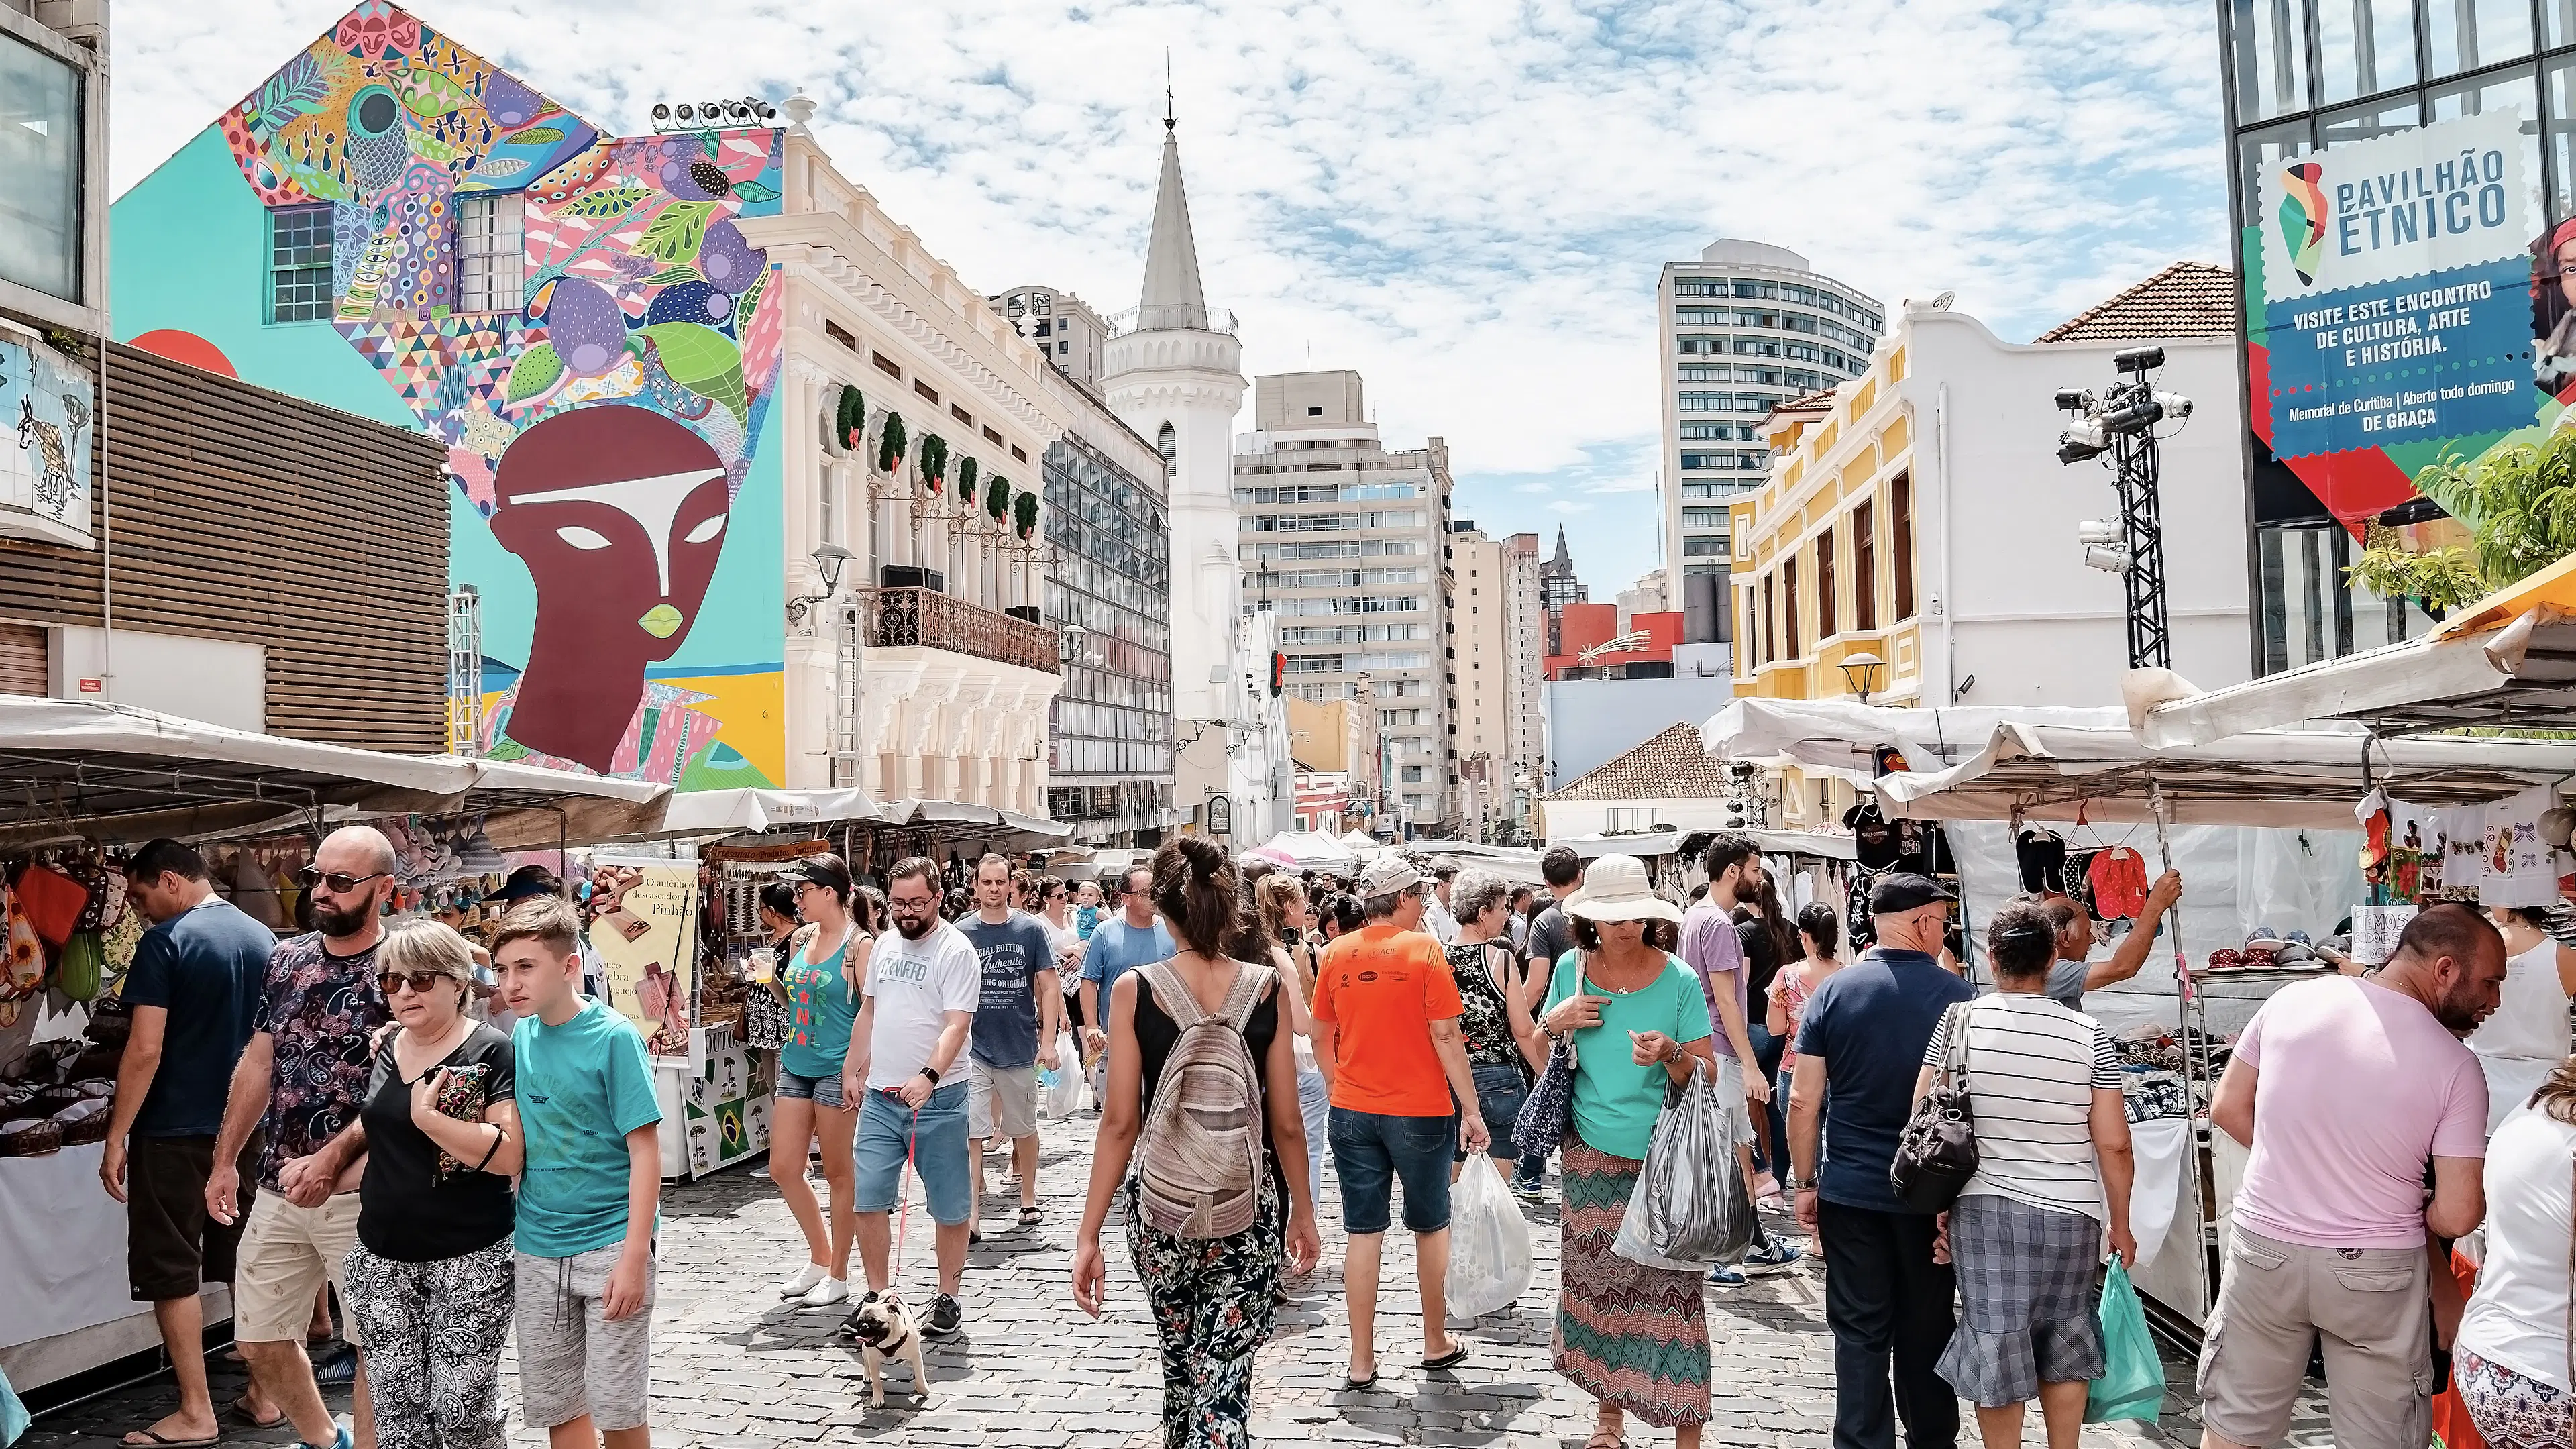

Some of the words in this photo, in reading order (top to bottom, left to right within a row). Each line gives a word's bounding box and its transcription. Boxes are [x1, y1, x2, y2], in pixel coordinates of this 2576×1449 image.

[2337, 148, 2503, 214] PAVILHÃO
[2339, 184, 2506, 256] ÉTNICO
[2293, 307, 2343, 331] VISITE
[2348, 299, 2390, 322] ESTE
[2396, 280, 2491, 314] ENCONTRO
[2316, 330, 2338, 350] DE
[2342, 316, 2422, 345] CULTURA,
[2428, 307, 2471, 331] ARTE
[2345, 349, 2356, 367] E
[2361, 335, 2447, 364] HISTÓRIA.
[2290, 405, 2335, 422] Memorial
[2338, 400, 2351, 415] de
[2353, 395, 2394, 413] Curitiba
[2403, 386, 2437, 406] Aberto
[2440, 385, 2464, 400] todo
[2467, 379, 2515, 397] domingo
[2363, 416, 2383, 433] DE
[2387, 407, 2436, 429] GRAÇA
[712, 848, 755, 859] Artesanato
[632, 890, 681, 900] descascador
[646, 877, 655, 886] O
[657, 879, 694, 889] autêntico
[2355, 909, 2409, 931] TEMOS
[996, 943, 1026, 957] EDITION
[608, 971, 629, 981] ebra
[981, 979, 996, 987] HING
[998, 975, 1028, 989] ORIGINAL
[705, 1028, 741, 1055] DUTO
